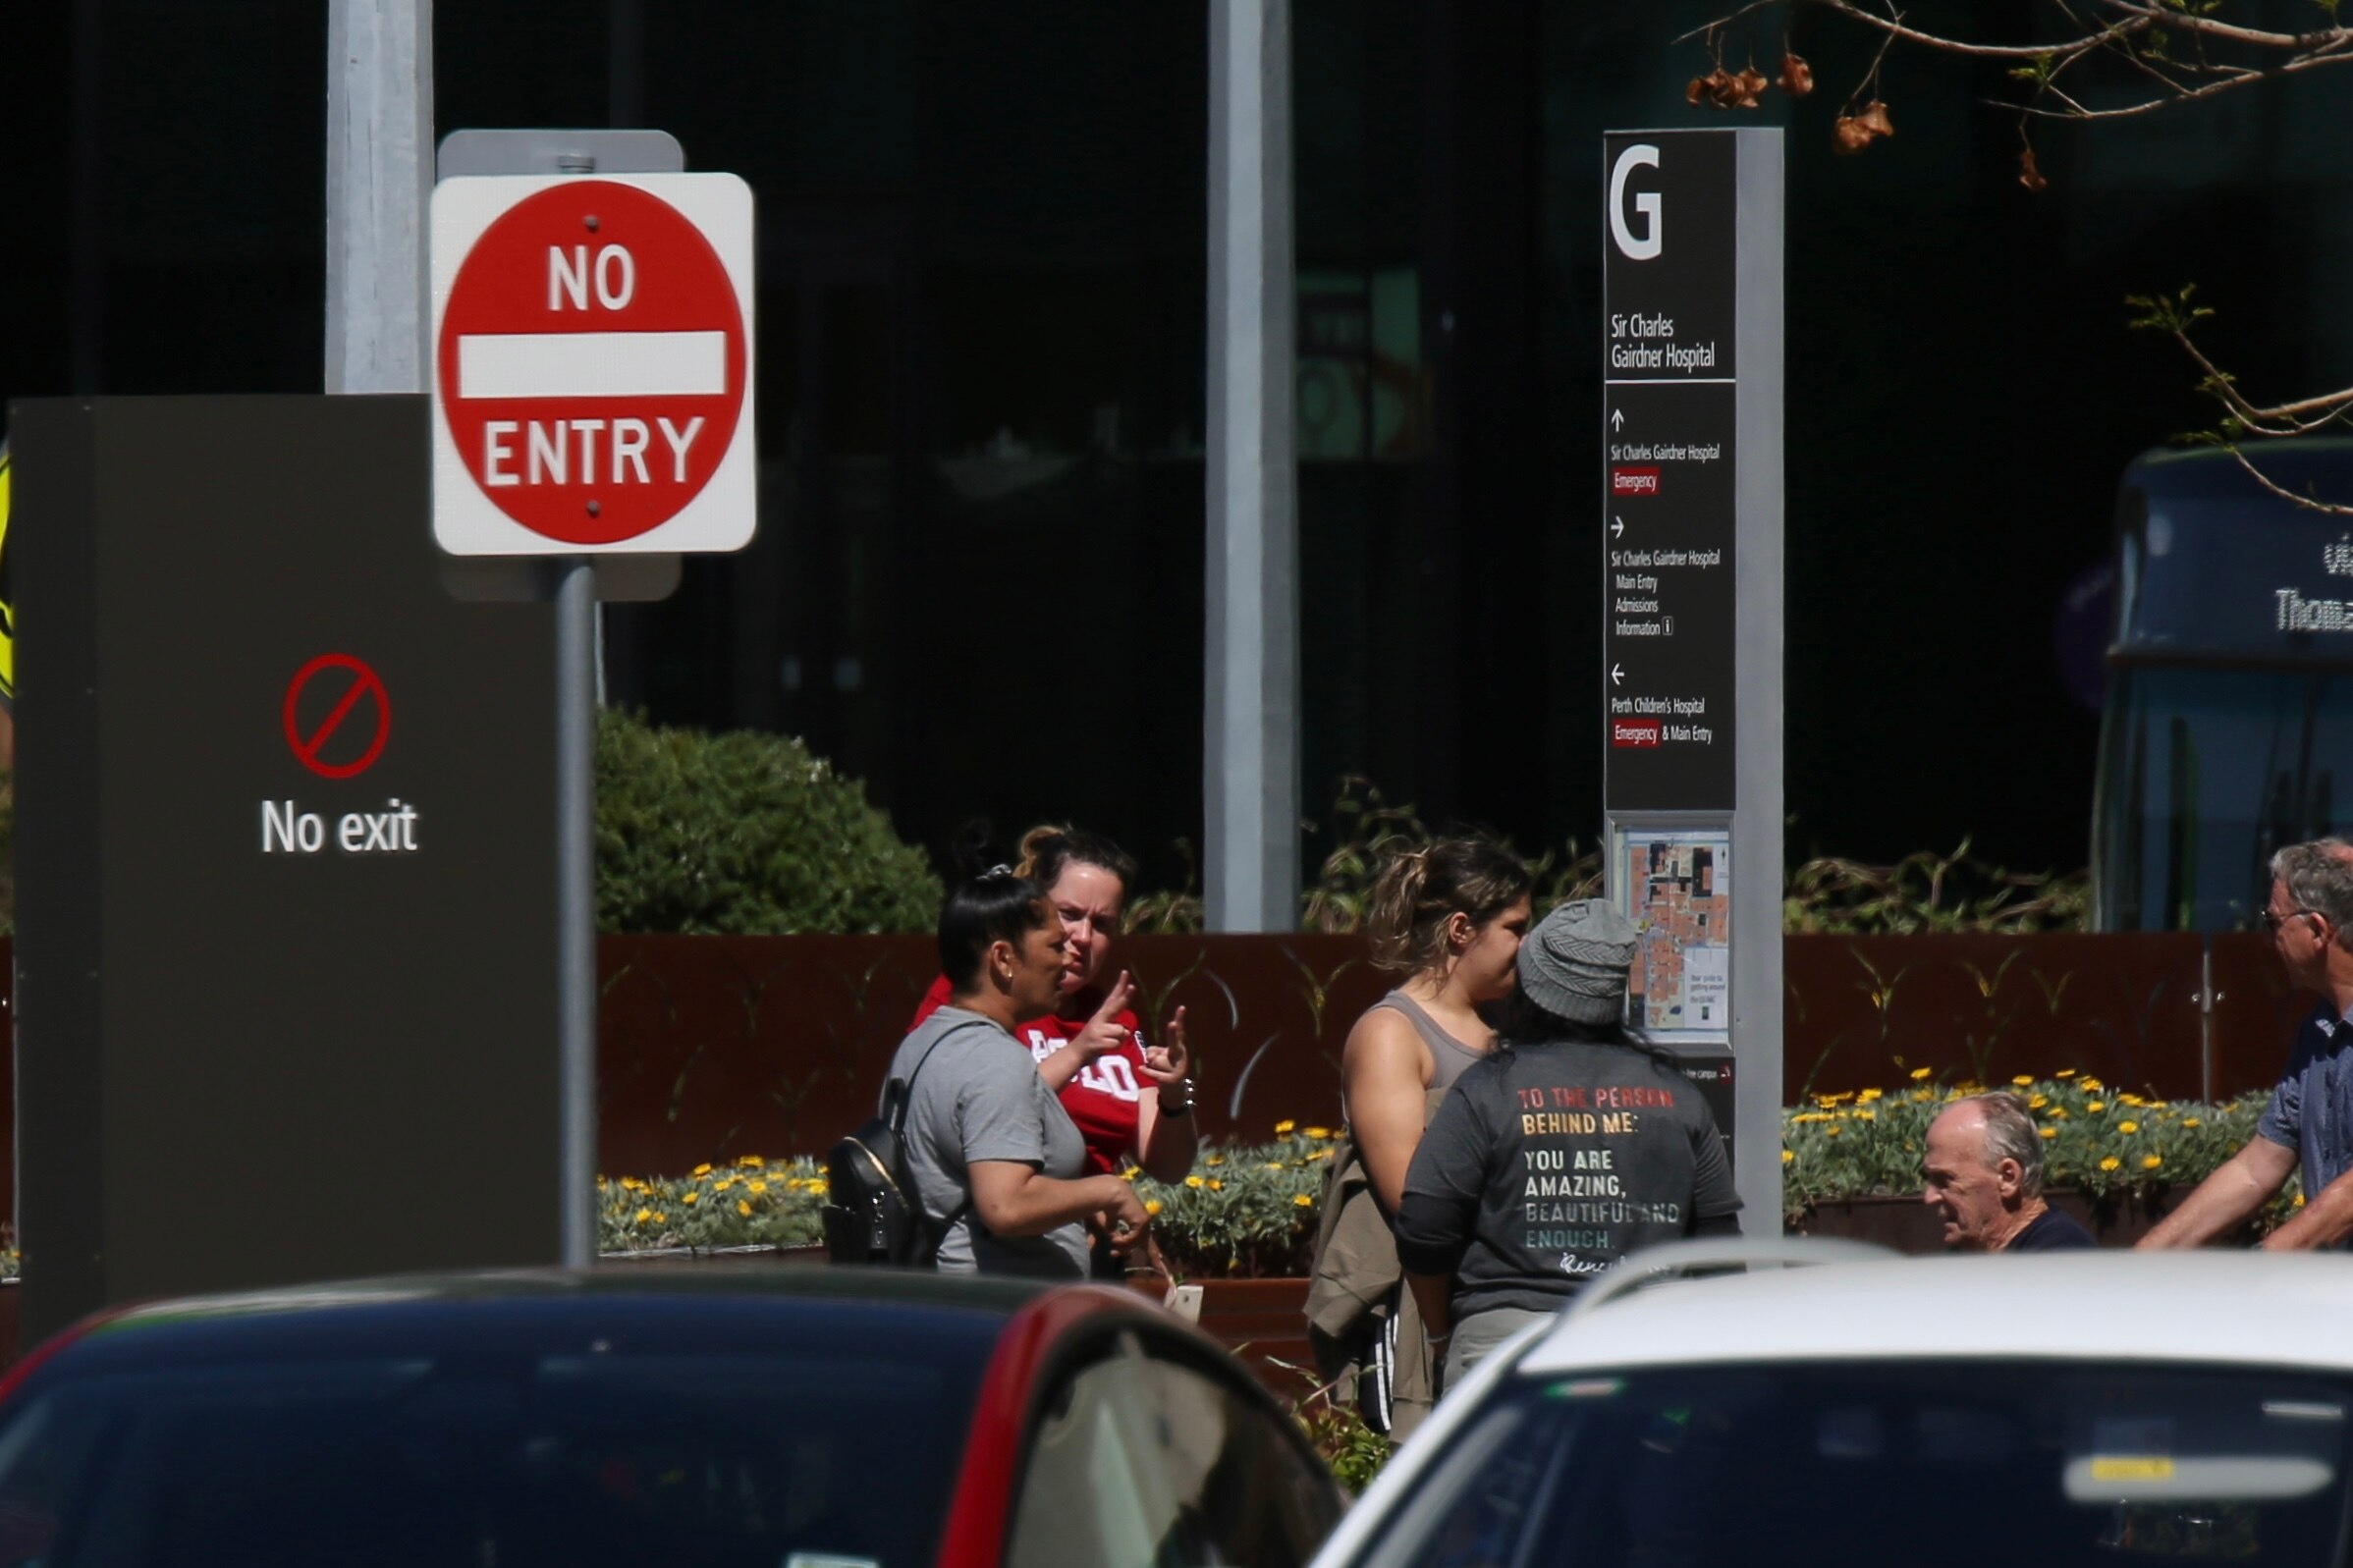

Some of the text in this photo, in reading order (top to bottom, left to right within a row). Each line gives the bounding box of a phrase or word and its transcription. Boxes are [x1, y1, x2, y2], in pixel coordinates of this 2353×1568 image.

[1610, 143, 1662, 261] G
[548, 243, 635, 311] NO
[1612, 312, 1673, 338] Sir Charles
[1612, 341, 1715, 374] Gairdner Hospital
[484, 416, 706, 485] ENTRY
[1611, 443, 1720, 463] Sir Charles Gairdner Hospital
[1614, 472, 1658, 492] Emergency
[1612, 548, 1721, 569] Sir Charles Gairdner Hospital
[1616, 573, 1658, 593] Main Entry
[1615, 597, 1659, 614] Admissions
[1615, 620, 1660, 635] Information
[1612, 697, 1706, 717] Perth Children's Hospital
[1615, 725, 1712, 744] Emergency & Main Entry
[261, 798, 418, 852] No exit
[1517, 1086, 1674, 1108] TO THE PERSON
[1522, 1111, 1639, 1135] BEHIND ME:
[1524, 1150, 1614, 1170] YOU ARE
[1524, 1175, 1626, 1199] AMAZING,
[1525, 1202, 1679, 1223] BEAUTIFUL AND
[1525, 1229, 1615, 1250] ENOUGH.
